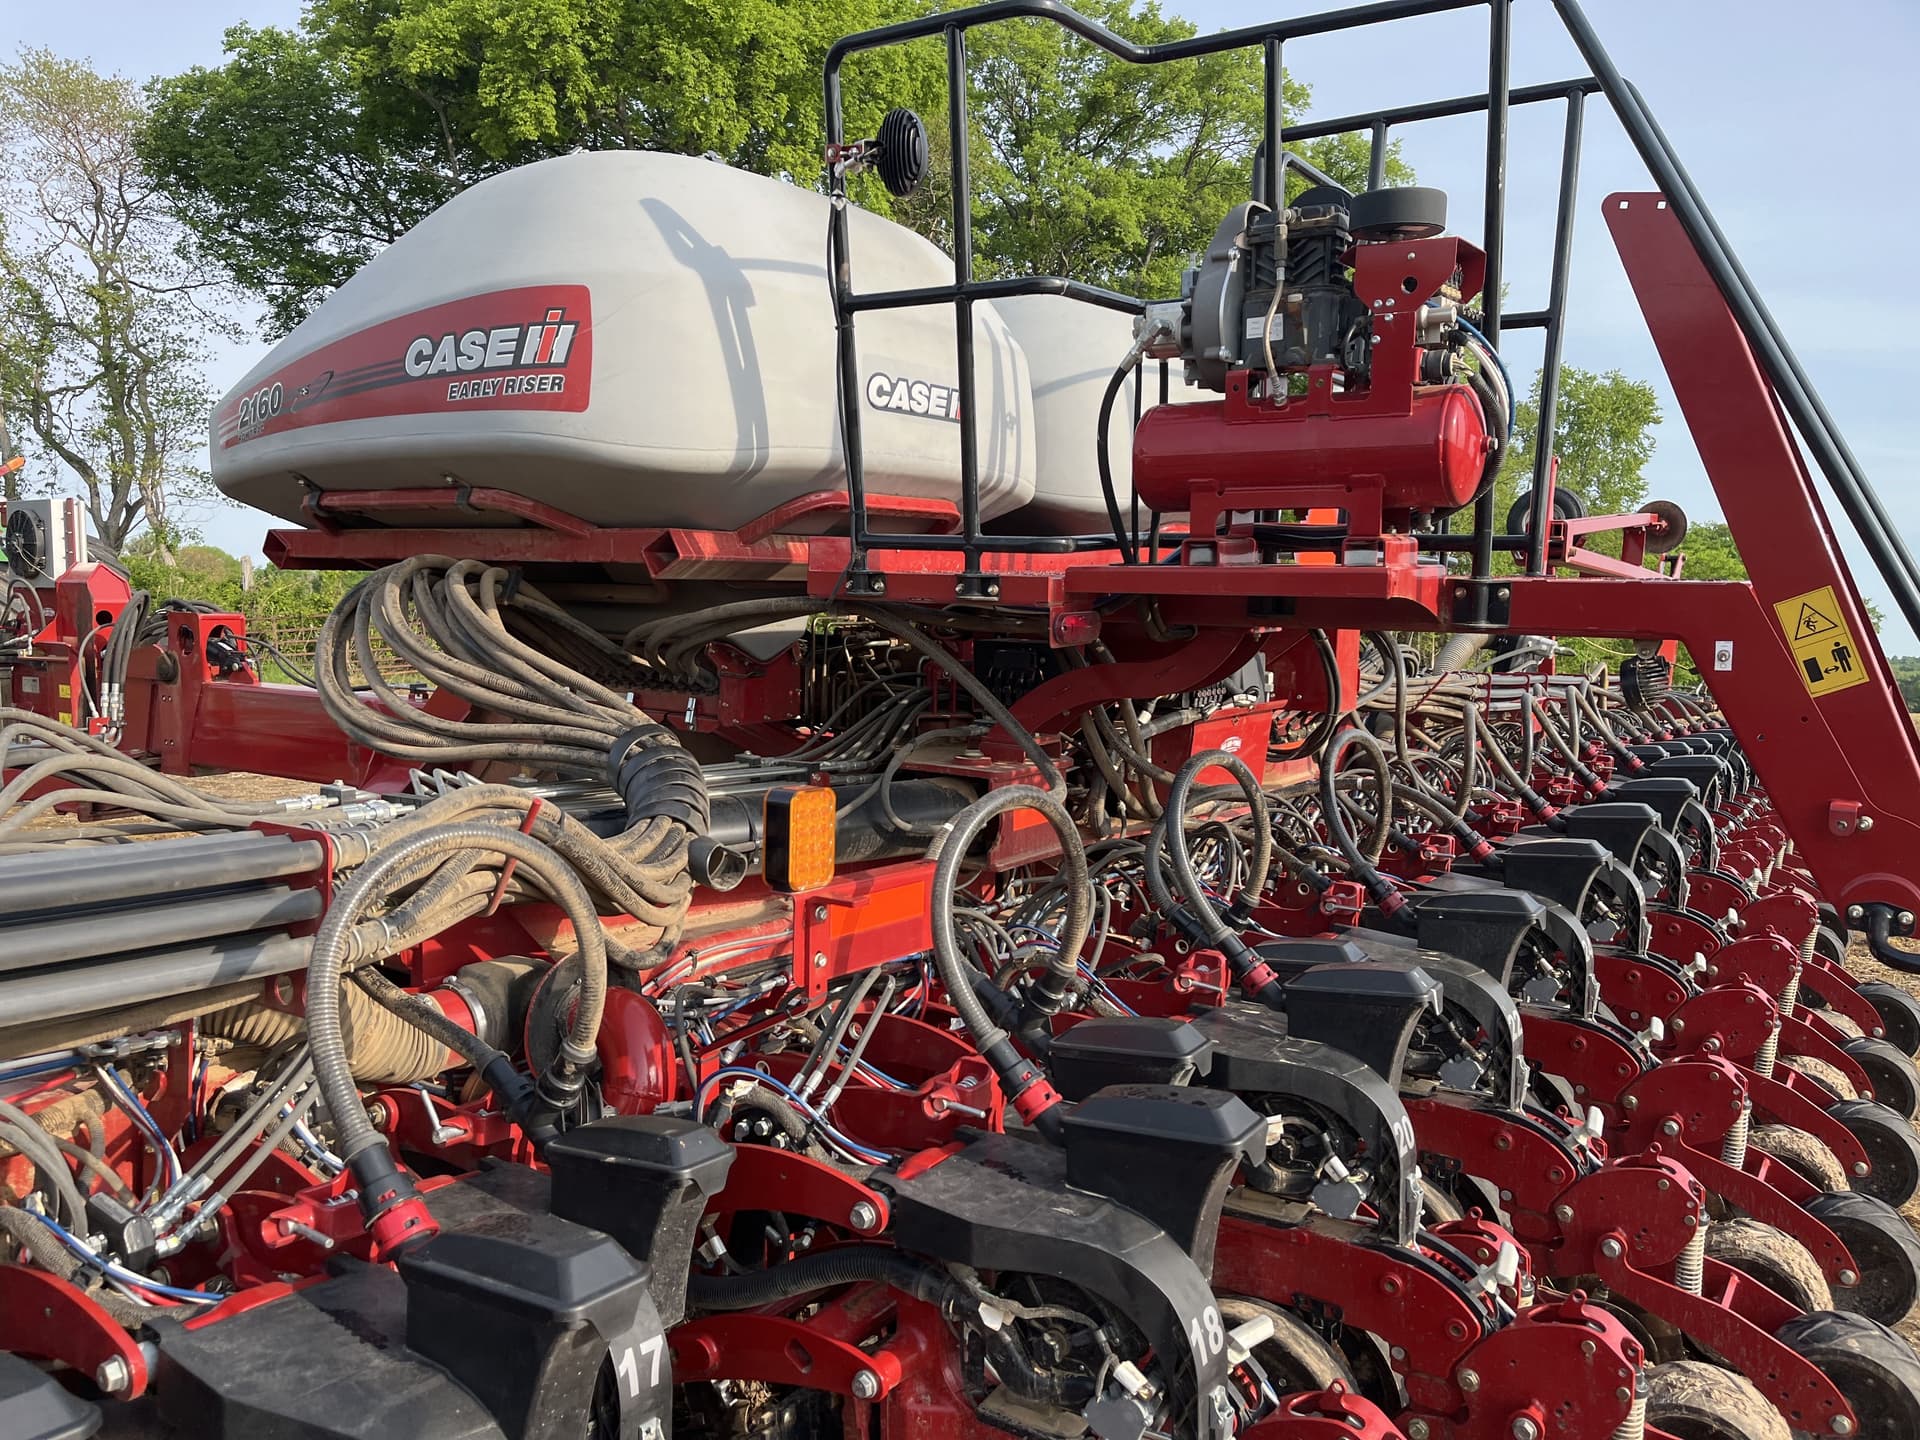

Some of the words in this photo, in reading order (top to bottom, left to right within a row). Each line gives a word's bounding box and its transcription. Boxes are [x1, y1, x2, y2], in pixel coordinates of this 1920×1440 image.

[405, 327, 521, 377] CASE
[238, 382, 283, 431] 2160
[447, 377, 502, 402] EARLY
[502, 374, 566, 396] RISER
[868, 374, 949, 417] CASE
[1393, 1115, 1415, 1159] 20
[1190, 1305, 1224, 1367] 18
[618, 1334, 664, 1398] 17
